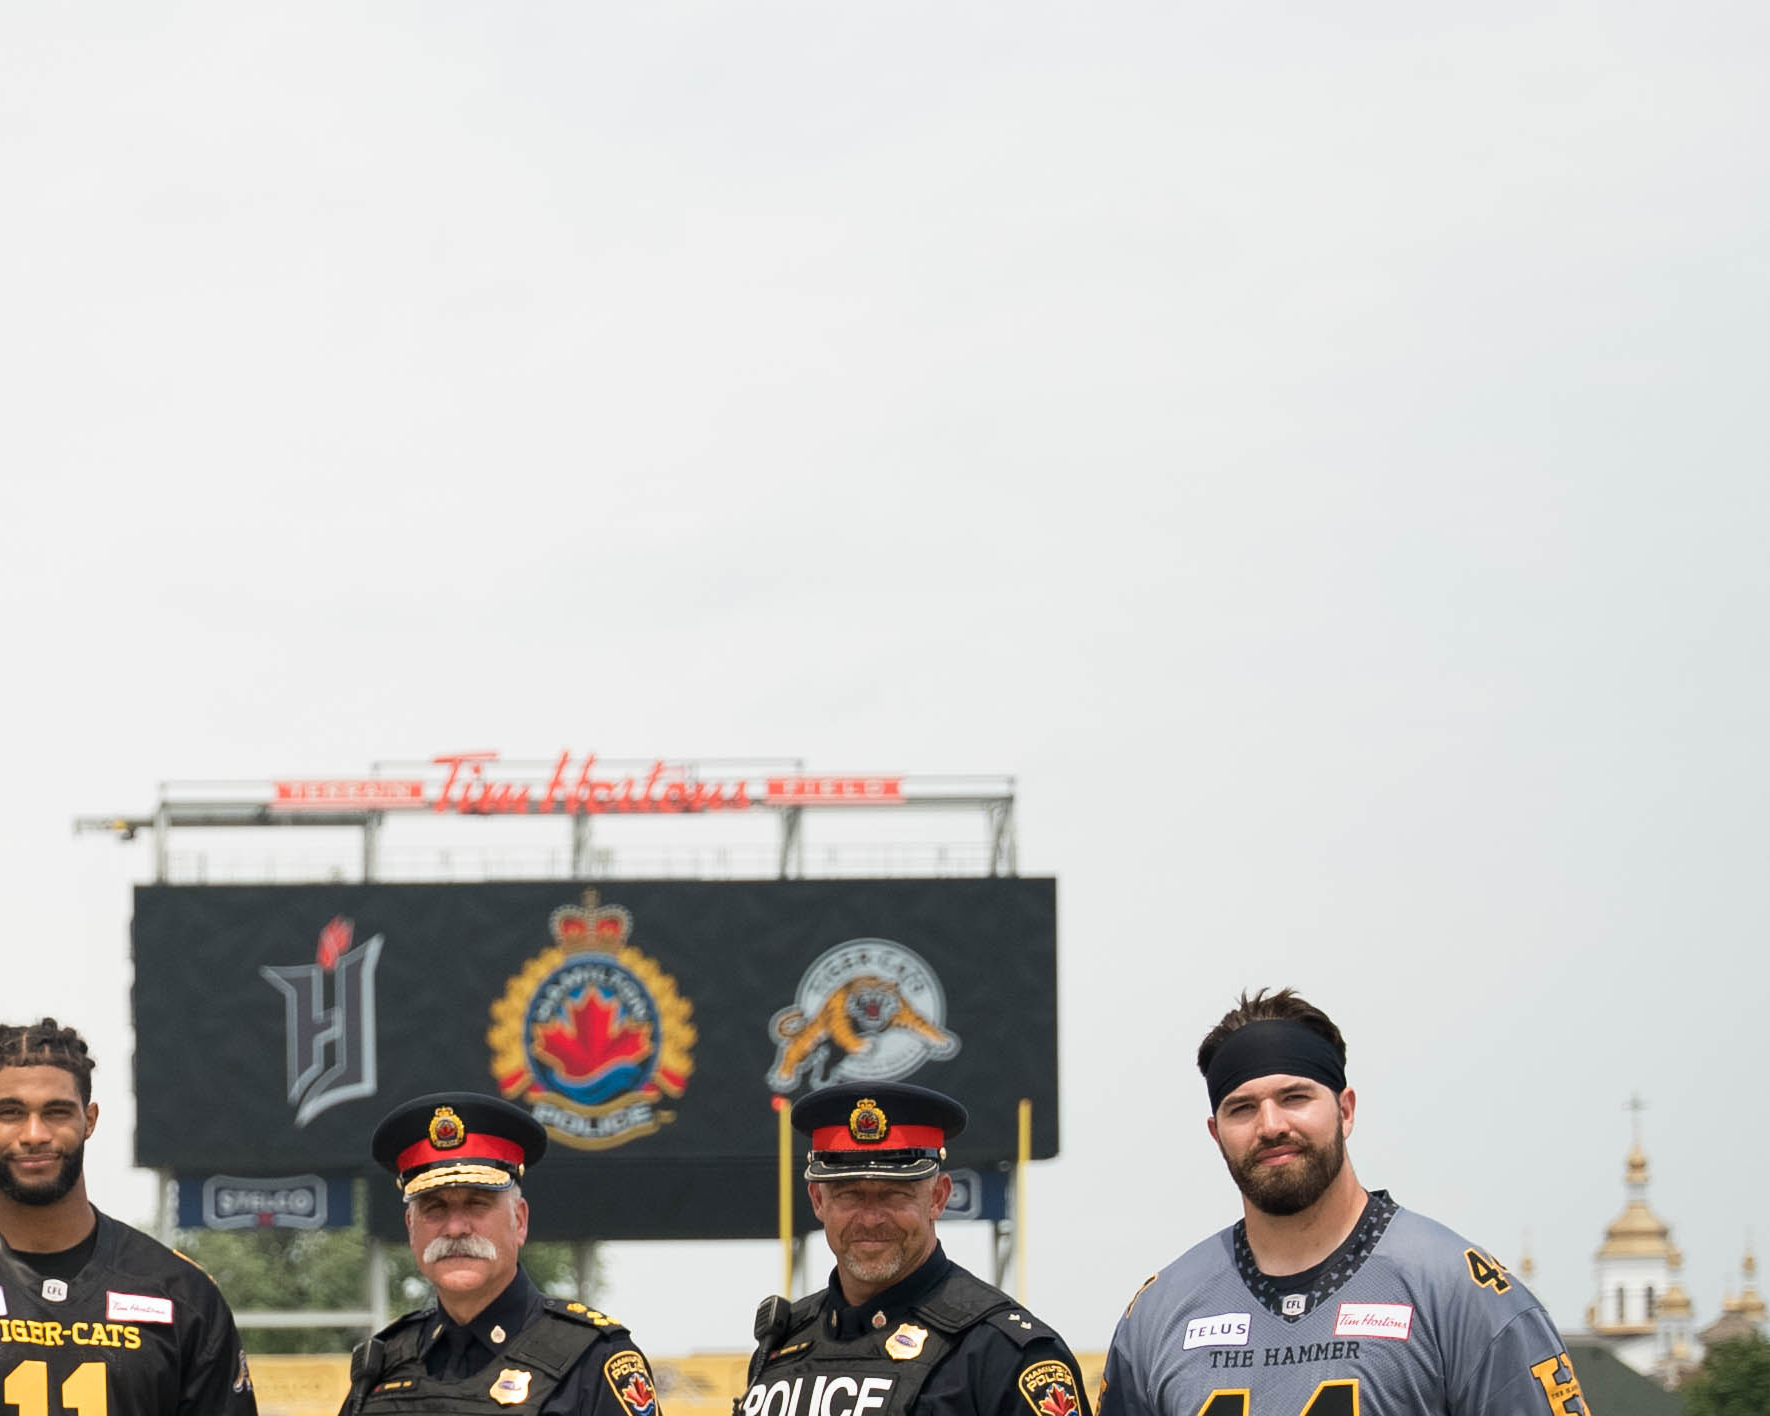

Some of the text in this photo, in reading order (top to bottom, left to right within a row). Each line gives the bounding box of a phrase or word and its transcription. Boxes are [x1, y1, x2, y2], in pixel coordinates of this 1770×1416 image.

[432, 749, 750, 813] Tim Hortons
[531, 1101, 654, 1139] POLICE
[1463, 1248, 1511, 1295] 4
[46, 1285, 63, 1297] CFL
[1286, 1299, 1301, 1310] CFL
[1188, 1322, 1247, 1340] TELUS
[1340, 1312, 1408, 1330] Tim Hortons
[1209, 1340, 1361, 1369] THE HAMMER
[1026, 1372, 1073, 1393] POLICE
